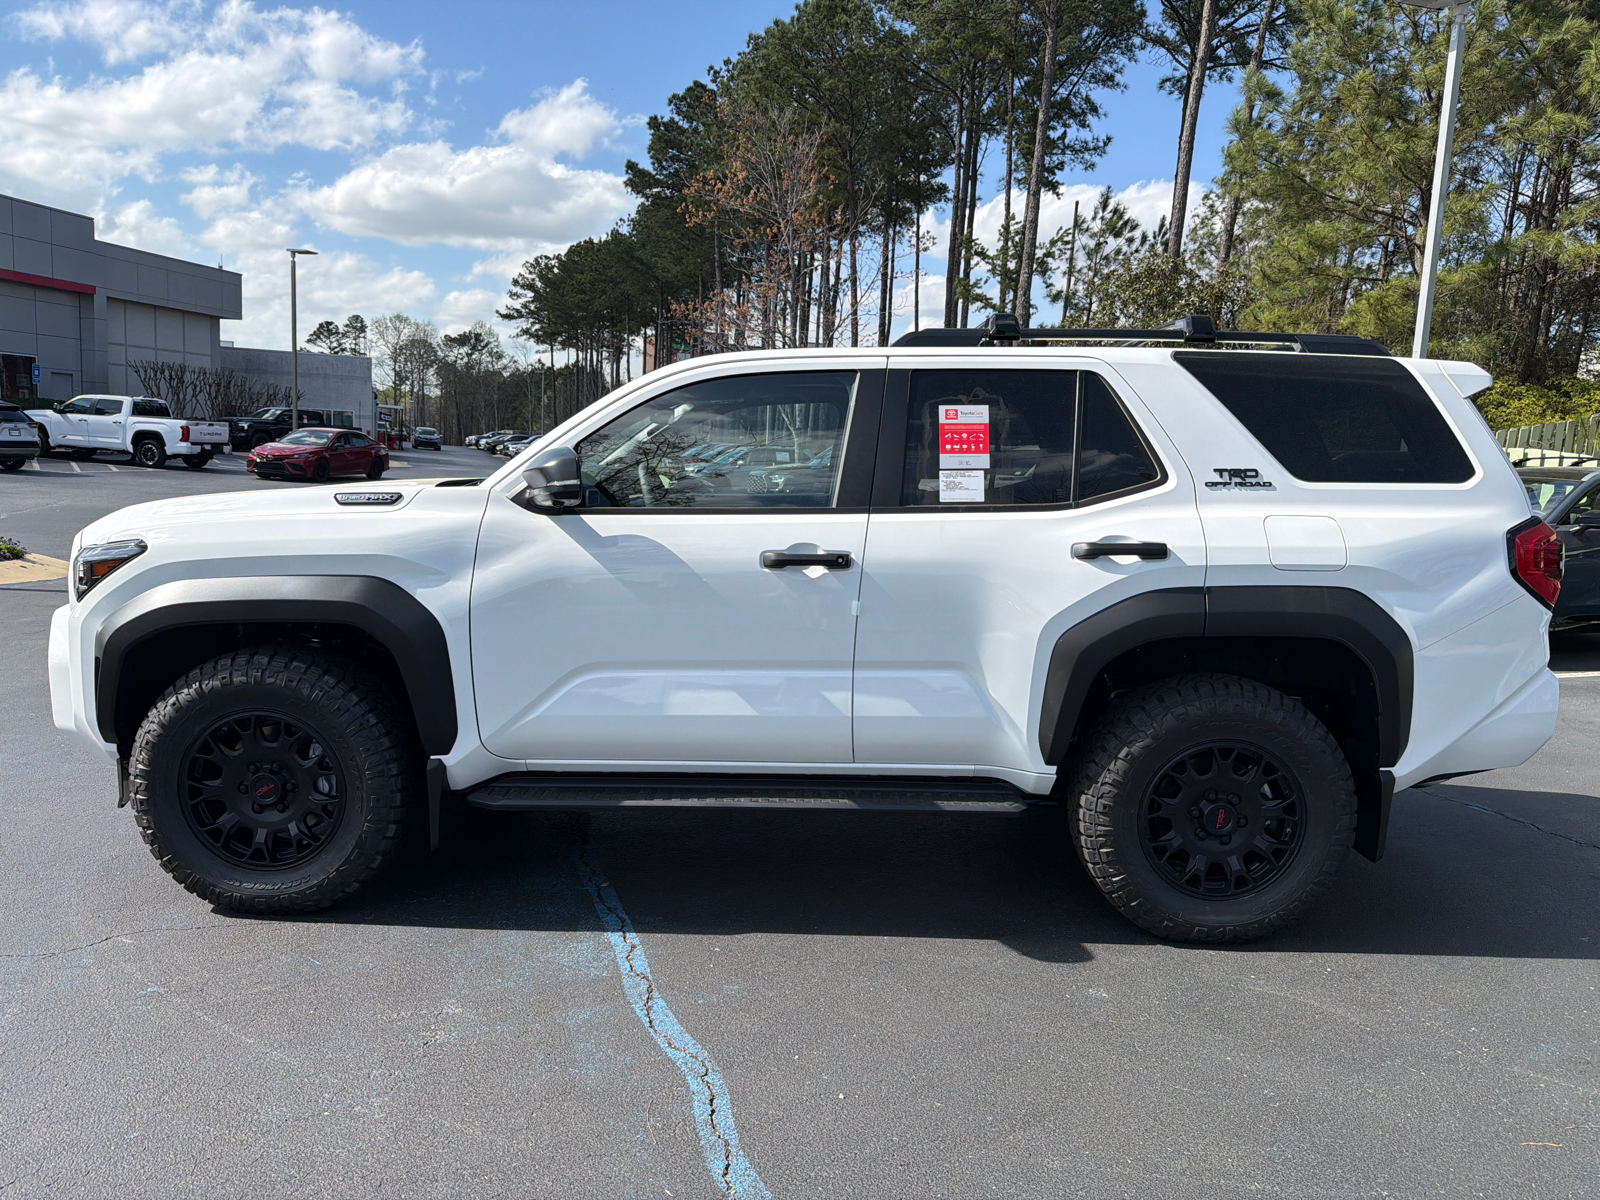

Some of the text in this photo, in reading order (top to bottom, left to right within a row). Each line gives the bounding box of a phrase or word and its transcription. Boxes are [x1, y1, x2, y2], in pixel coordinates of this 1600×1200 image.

[1213, 468, 1258, 481] TRD
[256, 783, 275, 796] TRD
[1215, 808, 1226, 830] TRD
